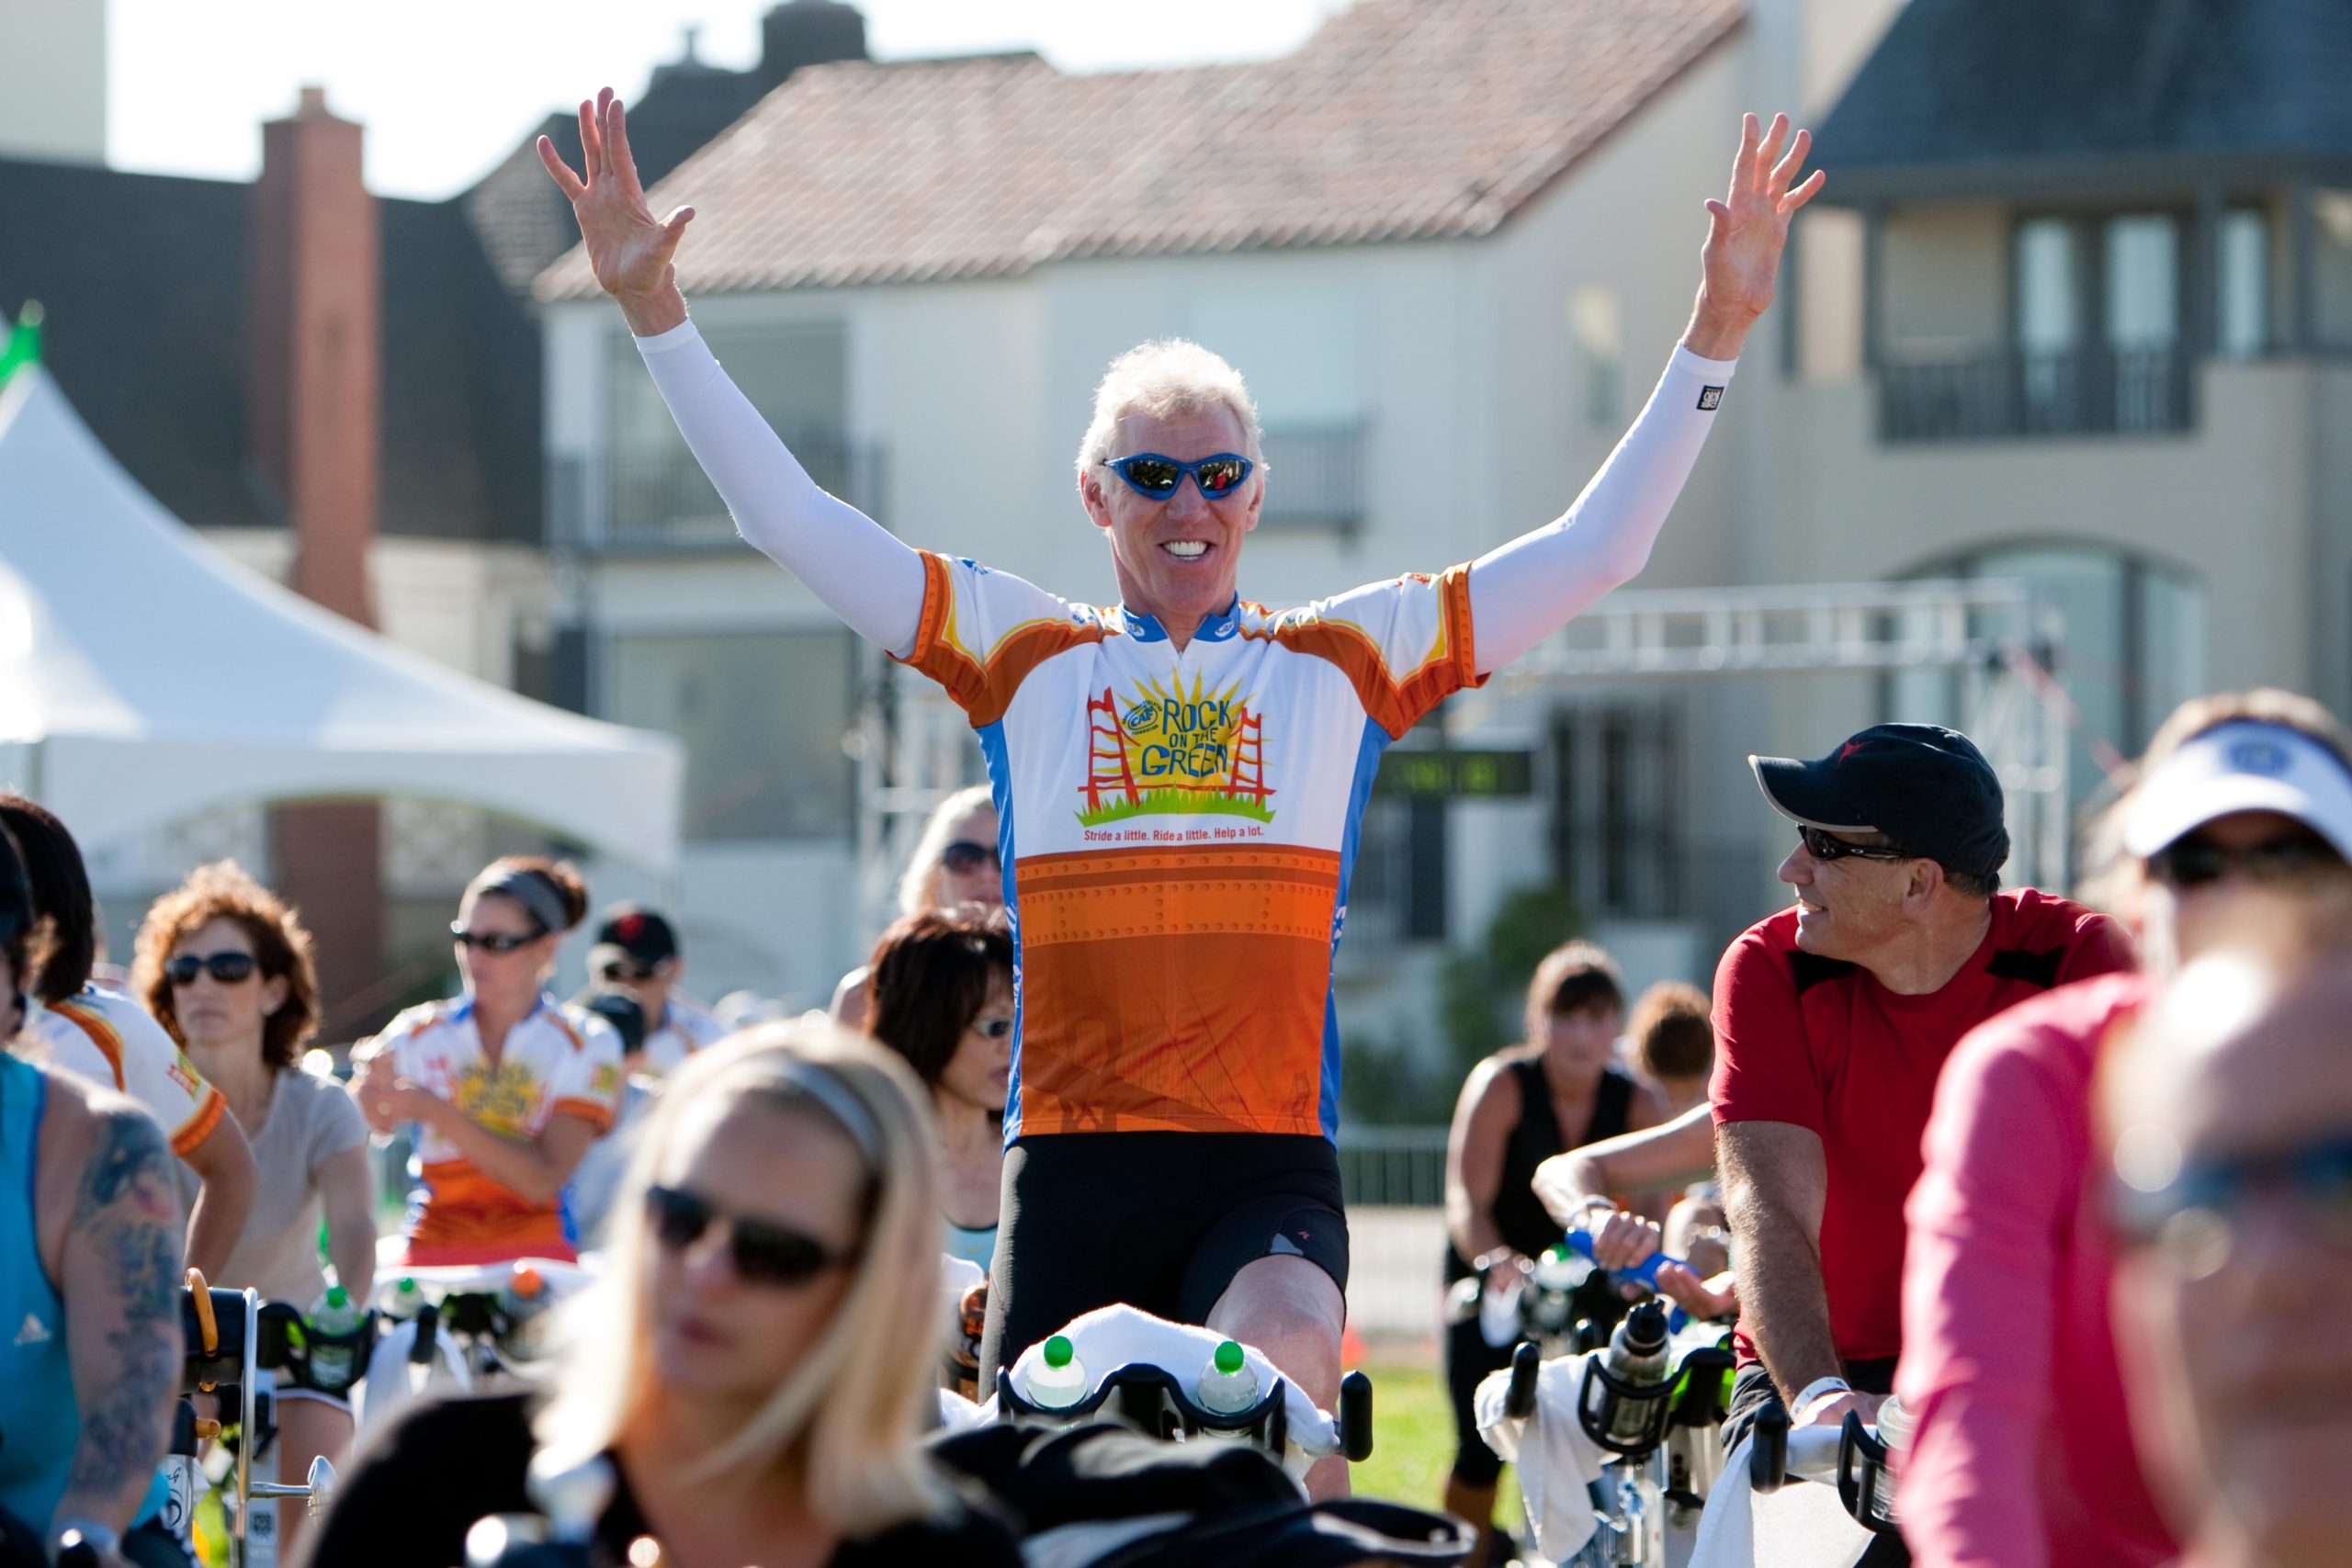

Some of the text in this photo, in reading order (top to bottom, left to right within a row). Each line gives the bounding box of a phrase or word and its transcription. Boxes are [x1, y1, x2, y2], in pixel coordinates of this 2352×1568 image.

[1131, 705, 1154, 728] CAF
[1162, 698, 1232, 735] ROCK
[1169, 727, 1218, 748] ON THE
[1141, 743, 1228, 778] GREEN
[1084, 825, 1264, 841] Stride a little. Ride a little. Help a lot.
